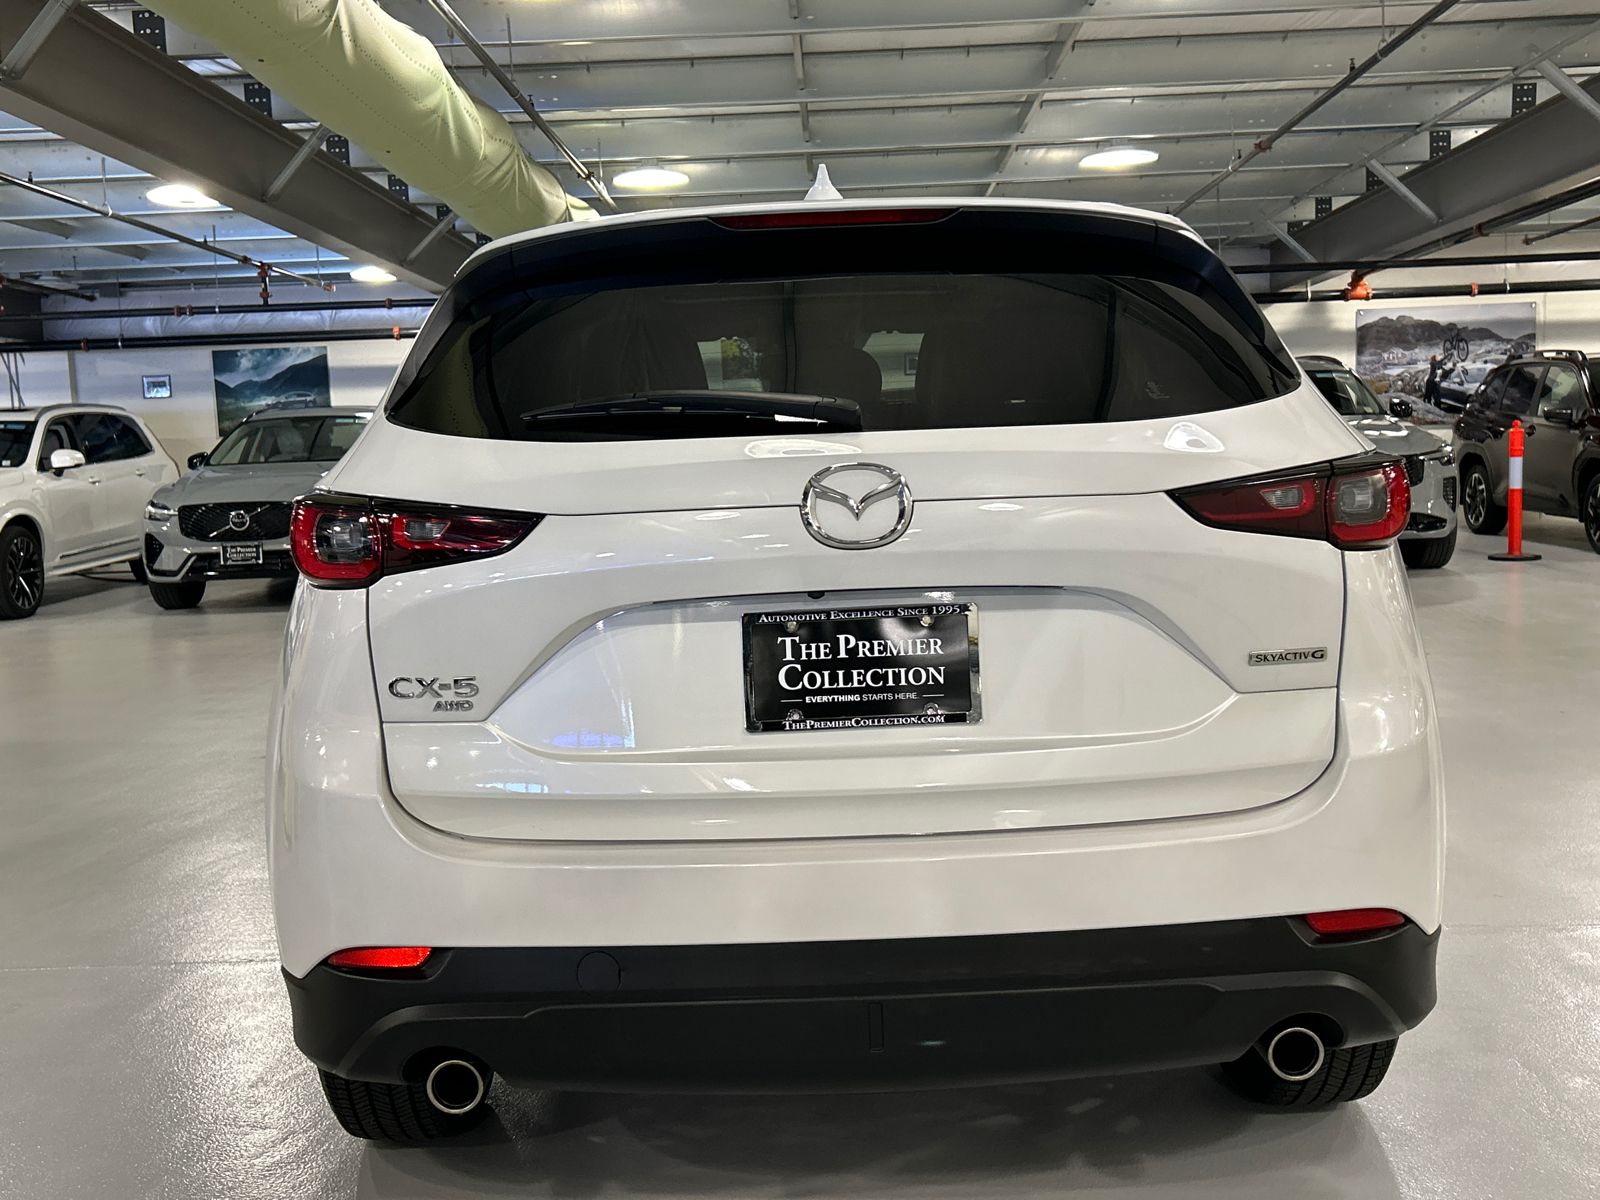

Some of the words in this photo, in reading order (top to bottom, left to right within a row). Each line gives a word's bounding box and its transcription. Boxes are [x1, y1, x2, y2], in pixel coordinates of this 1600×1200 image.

[759, 612, 827, 623] AUTOMOTIVE
[830, 608, 894, 619] EXCELLENCE
[897, 607, 928, 616] SINCE
[931, 605, 961, 615] 1995
[777, 636, 832, 661] THE
[836, 634, 944, 659] PREMIER
[388, 675, 480, 699] CX-5
[778, 664, 946, 691] COLLECTION
[432, 699, 474, 713] AWD
[805, 694, 861, 704] EVERYTHING
[862, 692, 894, 701] STARTS
